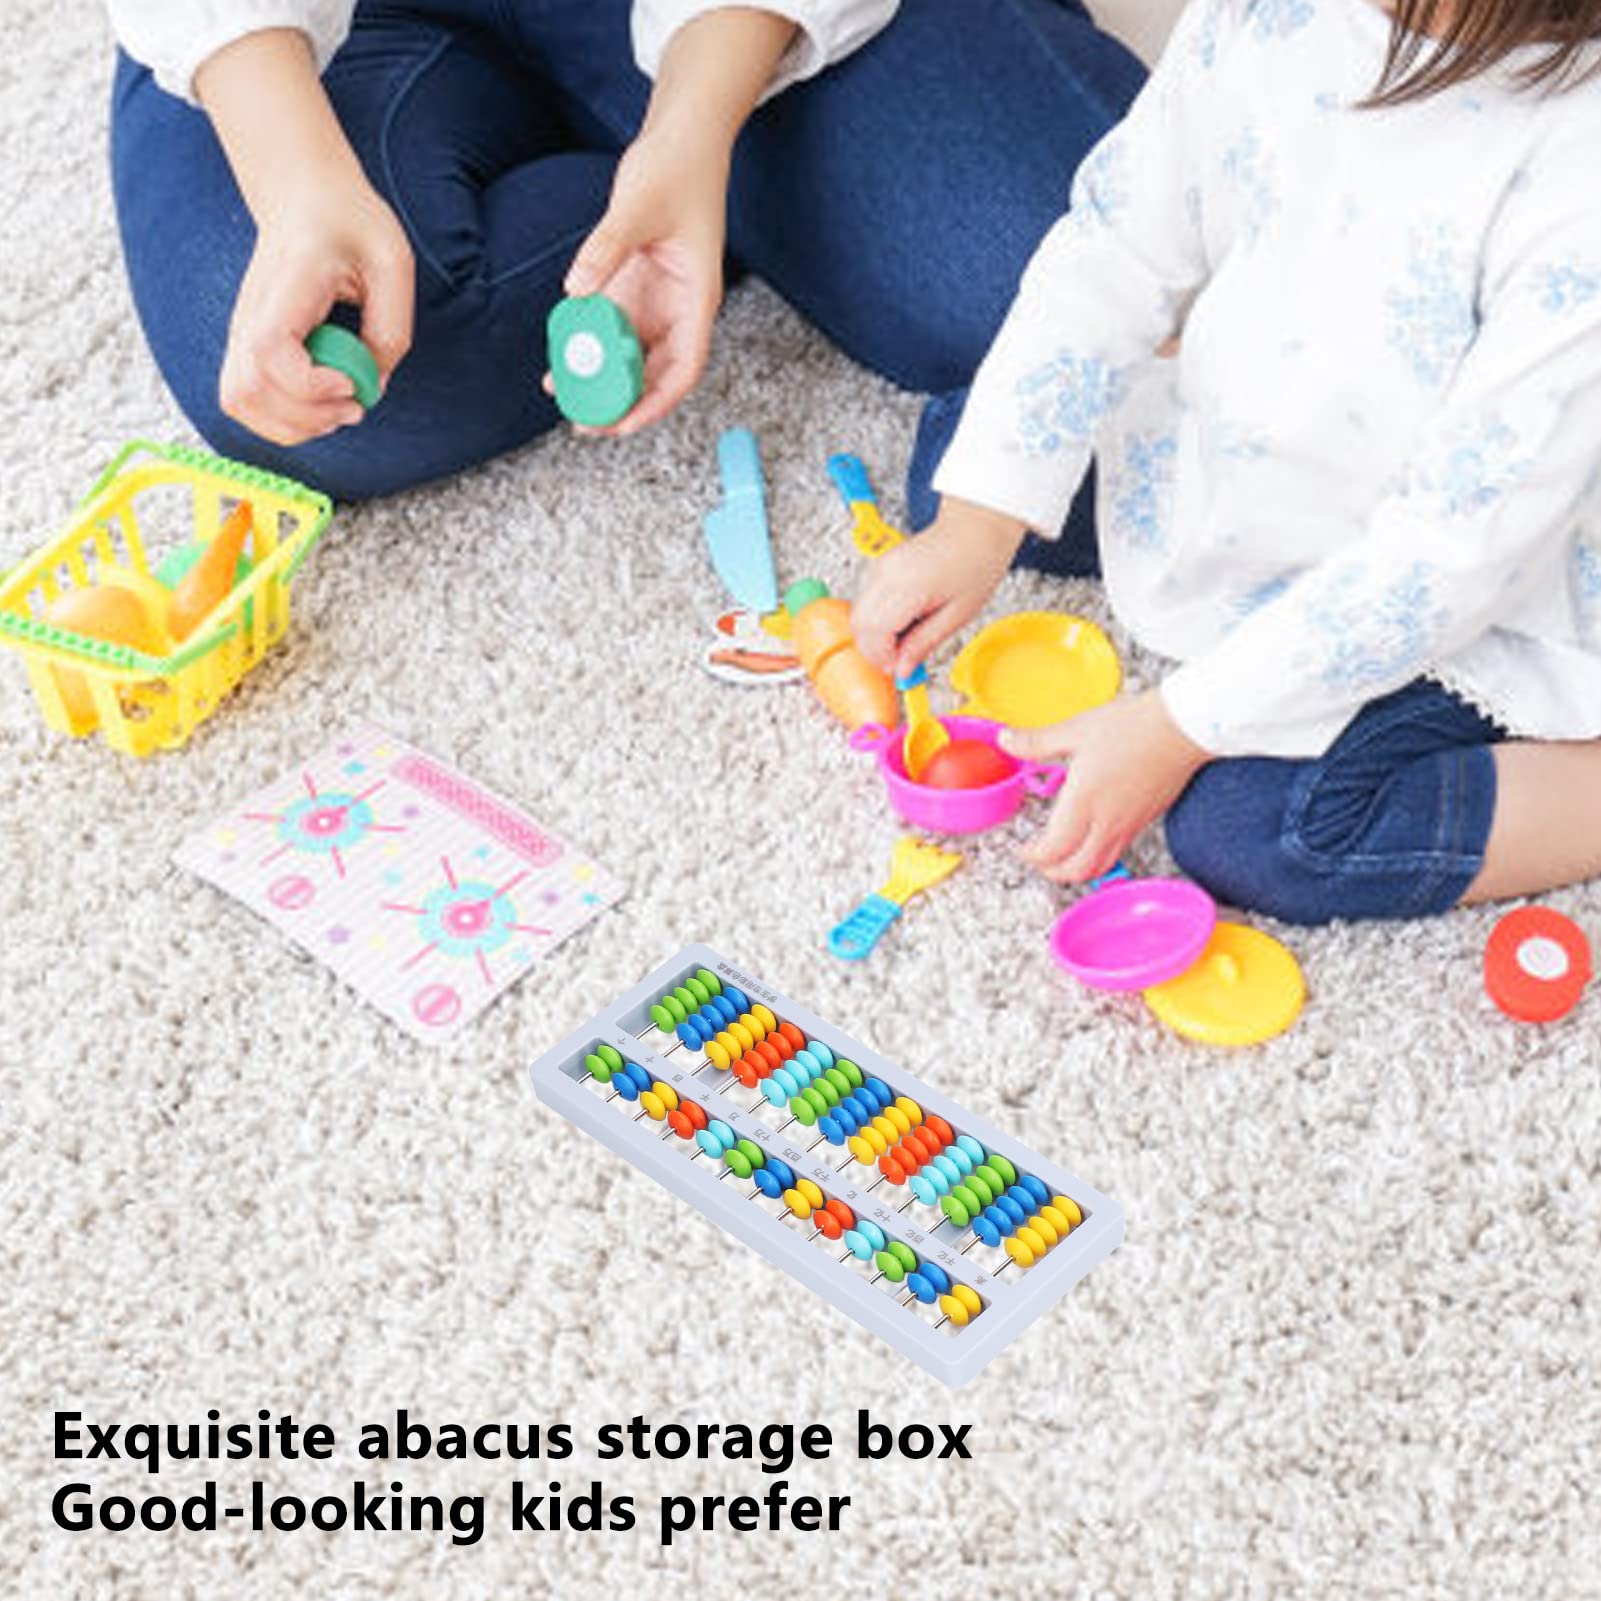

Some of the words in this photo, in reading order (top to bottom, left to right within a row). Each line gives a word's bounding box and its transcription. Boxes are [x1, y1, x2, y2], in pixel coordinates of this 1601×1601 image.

[753, 1128, 771, 1142] 十万
[782, 1148, 802, 1161] 百万
[811, 1167, 830, 1182] 千万
